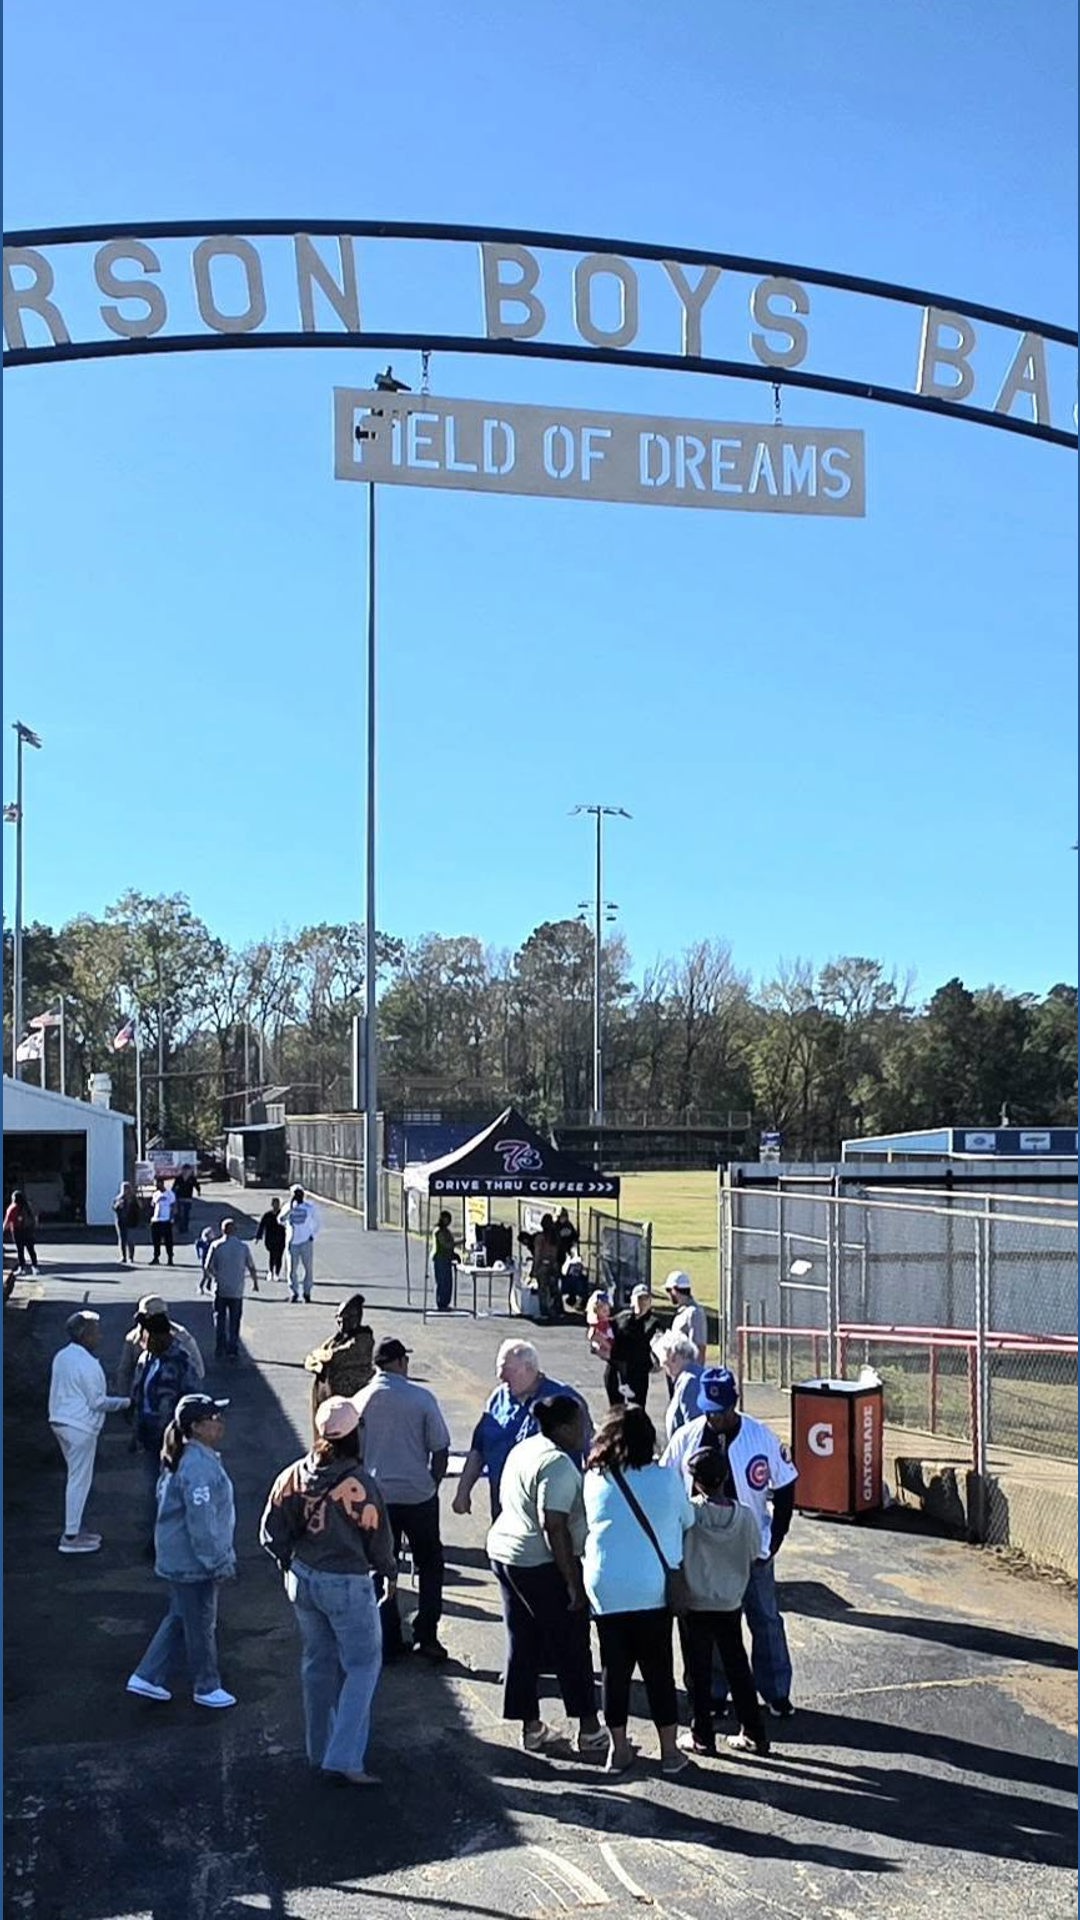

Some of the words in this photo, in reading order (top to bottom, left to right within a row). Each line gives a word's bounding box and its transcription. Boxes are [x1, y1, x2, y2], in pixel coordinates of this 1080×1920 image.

[480, 241, 811, 369] BOYS
[915, 305, 1078, 427] BA
[352, 406, 516, 475] FIELD
[543, 424, 612, 482] OF
[639, 432, 852, 499] DREAMS
[434, 1179, 481, 1191] DRIVE
[485, 1180, 523, 1191] THRU
[529, 1180, 585, 1193] COFFEE
[807, 1422, 835, 1457] G
[863, 1404, 874, 1502] GATORADE
